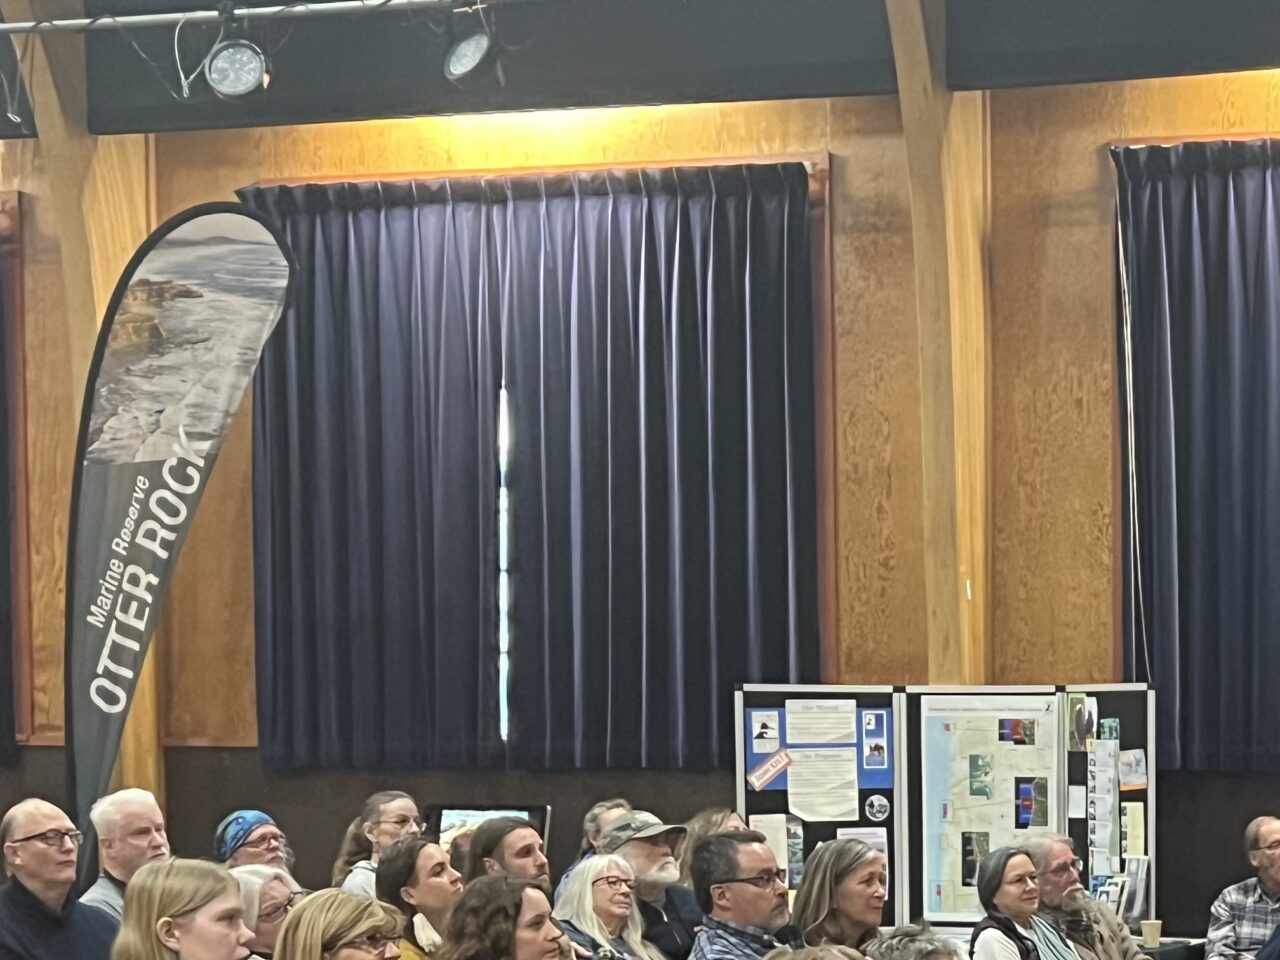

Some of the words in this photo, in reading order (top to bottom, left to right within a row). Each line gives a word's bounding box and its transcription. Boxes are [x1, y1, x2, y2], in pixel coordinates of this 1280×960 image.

[86, 558, 125, 628] Marine
[111, 475, 150, 556] Reserve
[89, 564, 160, 714] OTTER
[134, 423, 214, 560] ROCK
